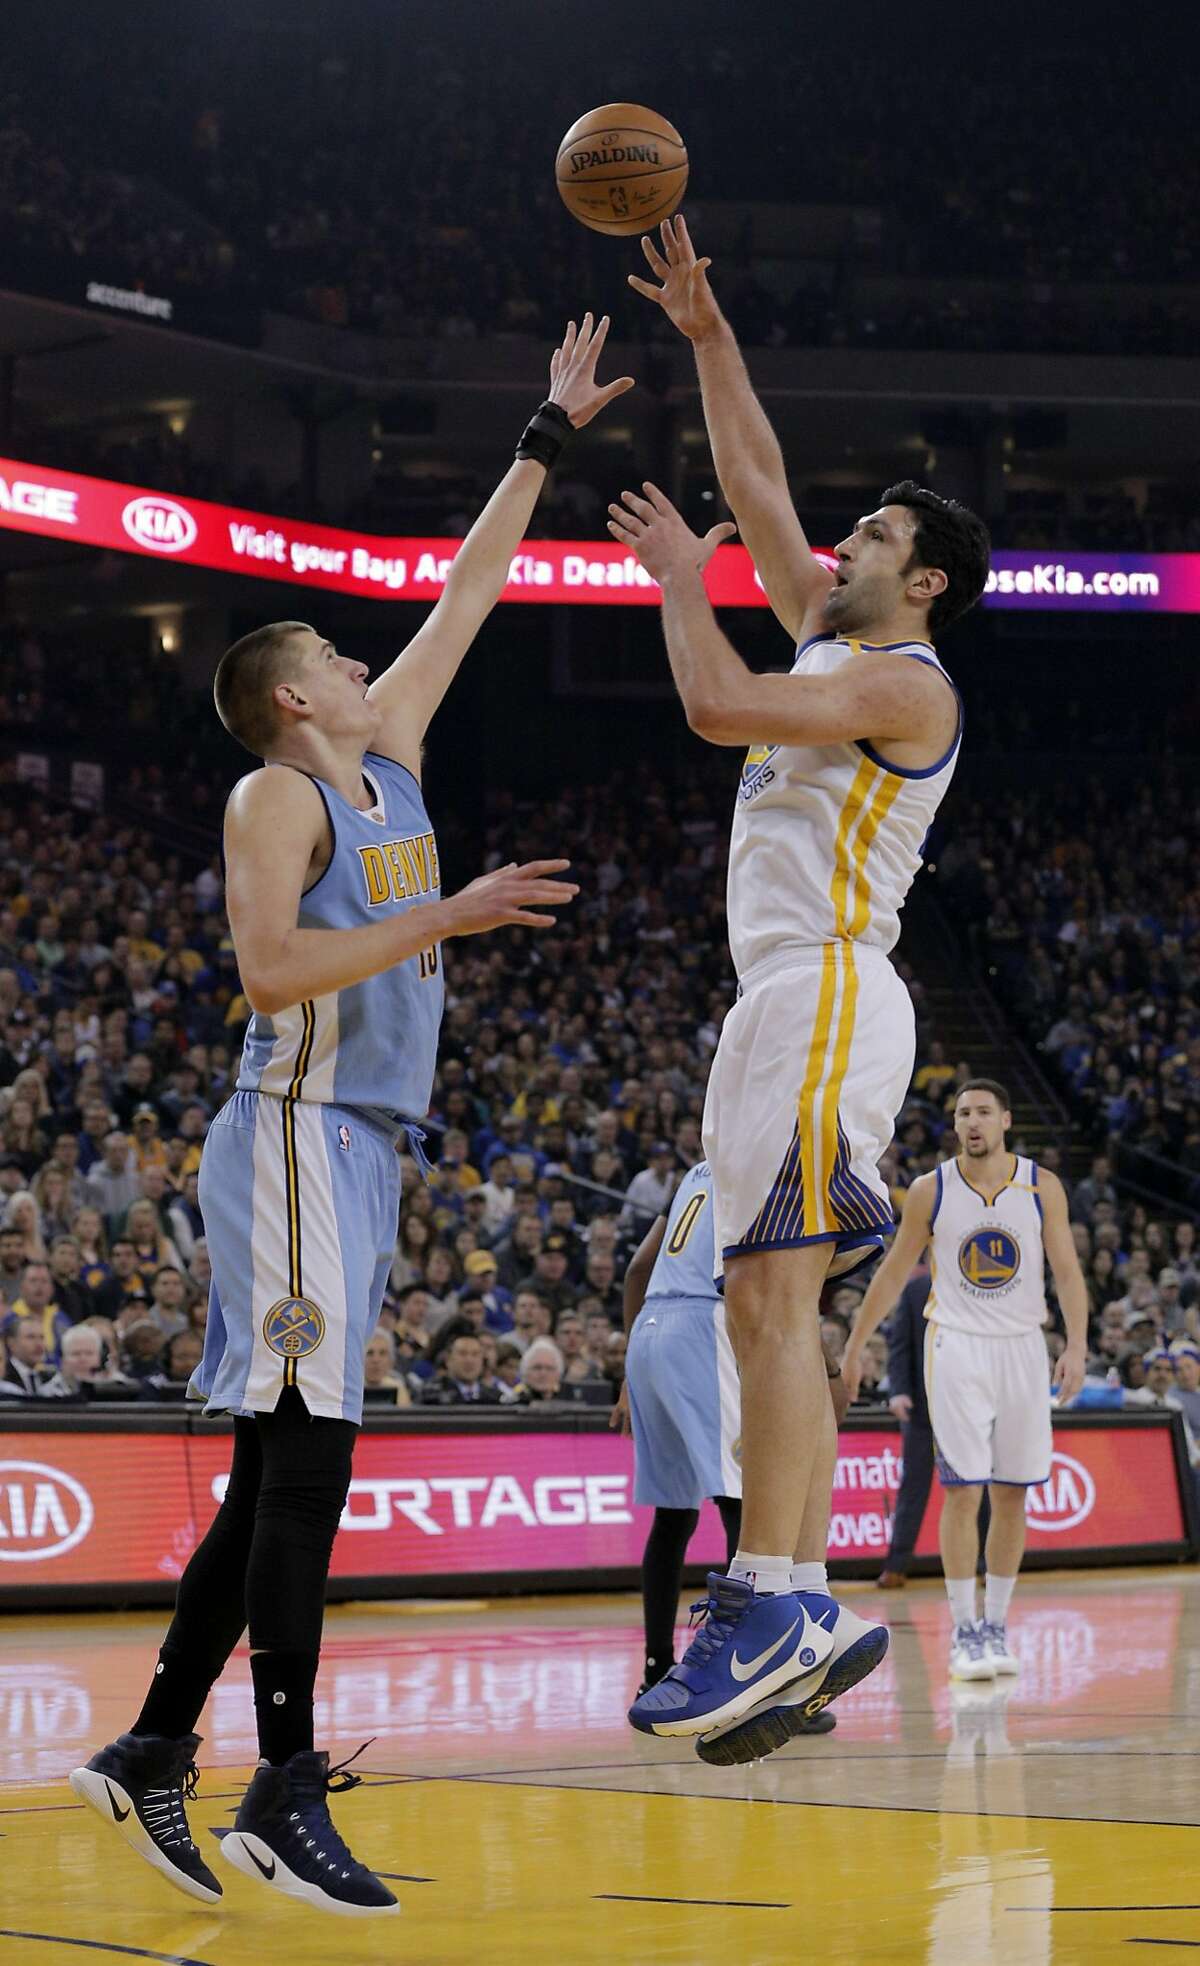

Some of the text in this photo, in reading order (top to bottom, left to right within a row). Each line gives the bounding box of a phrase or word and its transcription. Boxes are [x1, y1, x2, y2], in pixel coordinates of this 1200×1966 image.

[570, 145, 660, 175] SPALDING
[133, 505, 187, 543] KIA
[228, 521, 287, 564] Visit
[290, 541, 348, 574] your
[351, 548, 407, 589] Bay
[412, 553, 452, 583] Ar
[562, 555, 662, 588] Deale
[666, 1188, 708, 1258] 0
[989, 1239, 1004, 1257] 11
[959, 1277, 1023, 1301] WARRIORS
[0, 1483, 71, 1538] IA
[211, 1472, 634, 1536] ORTAGE
